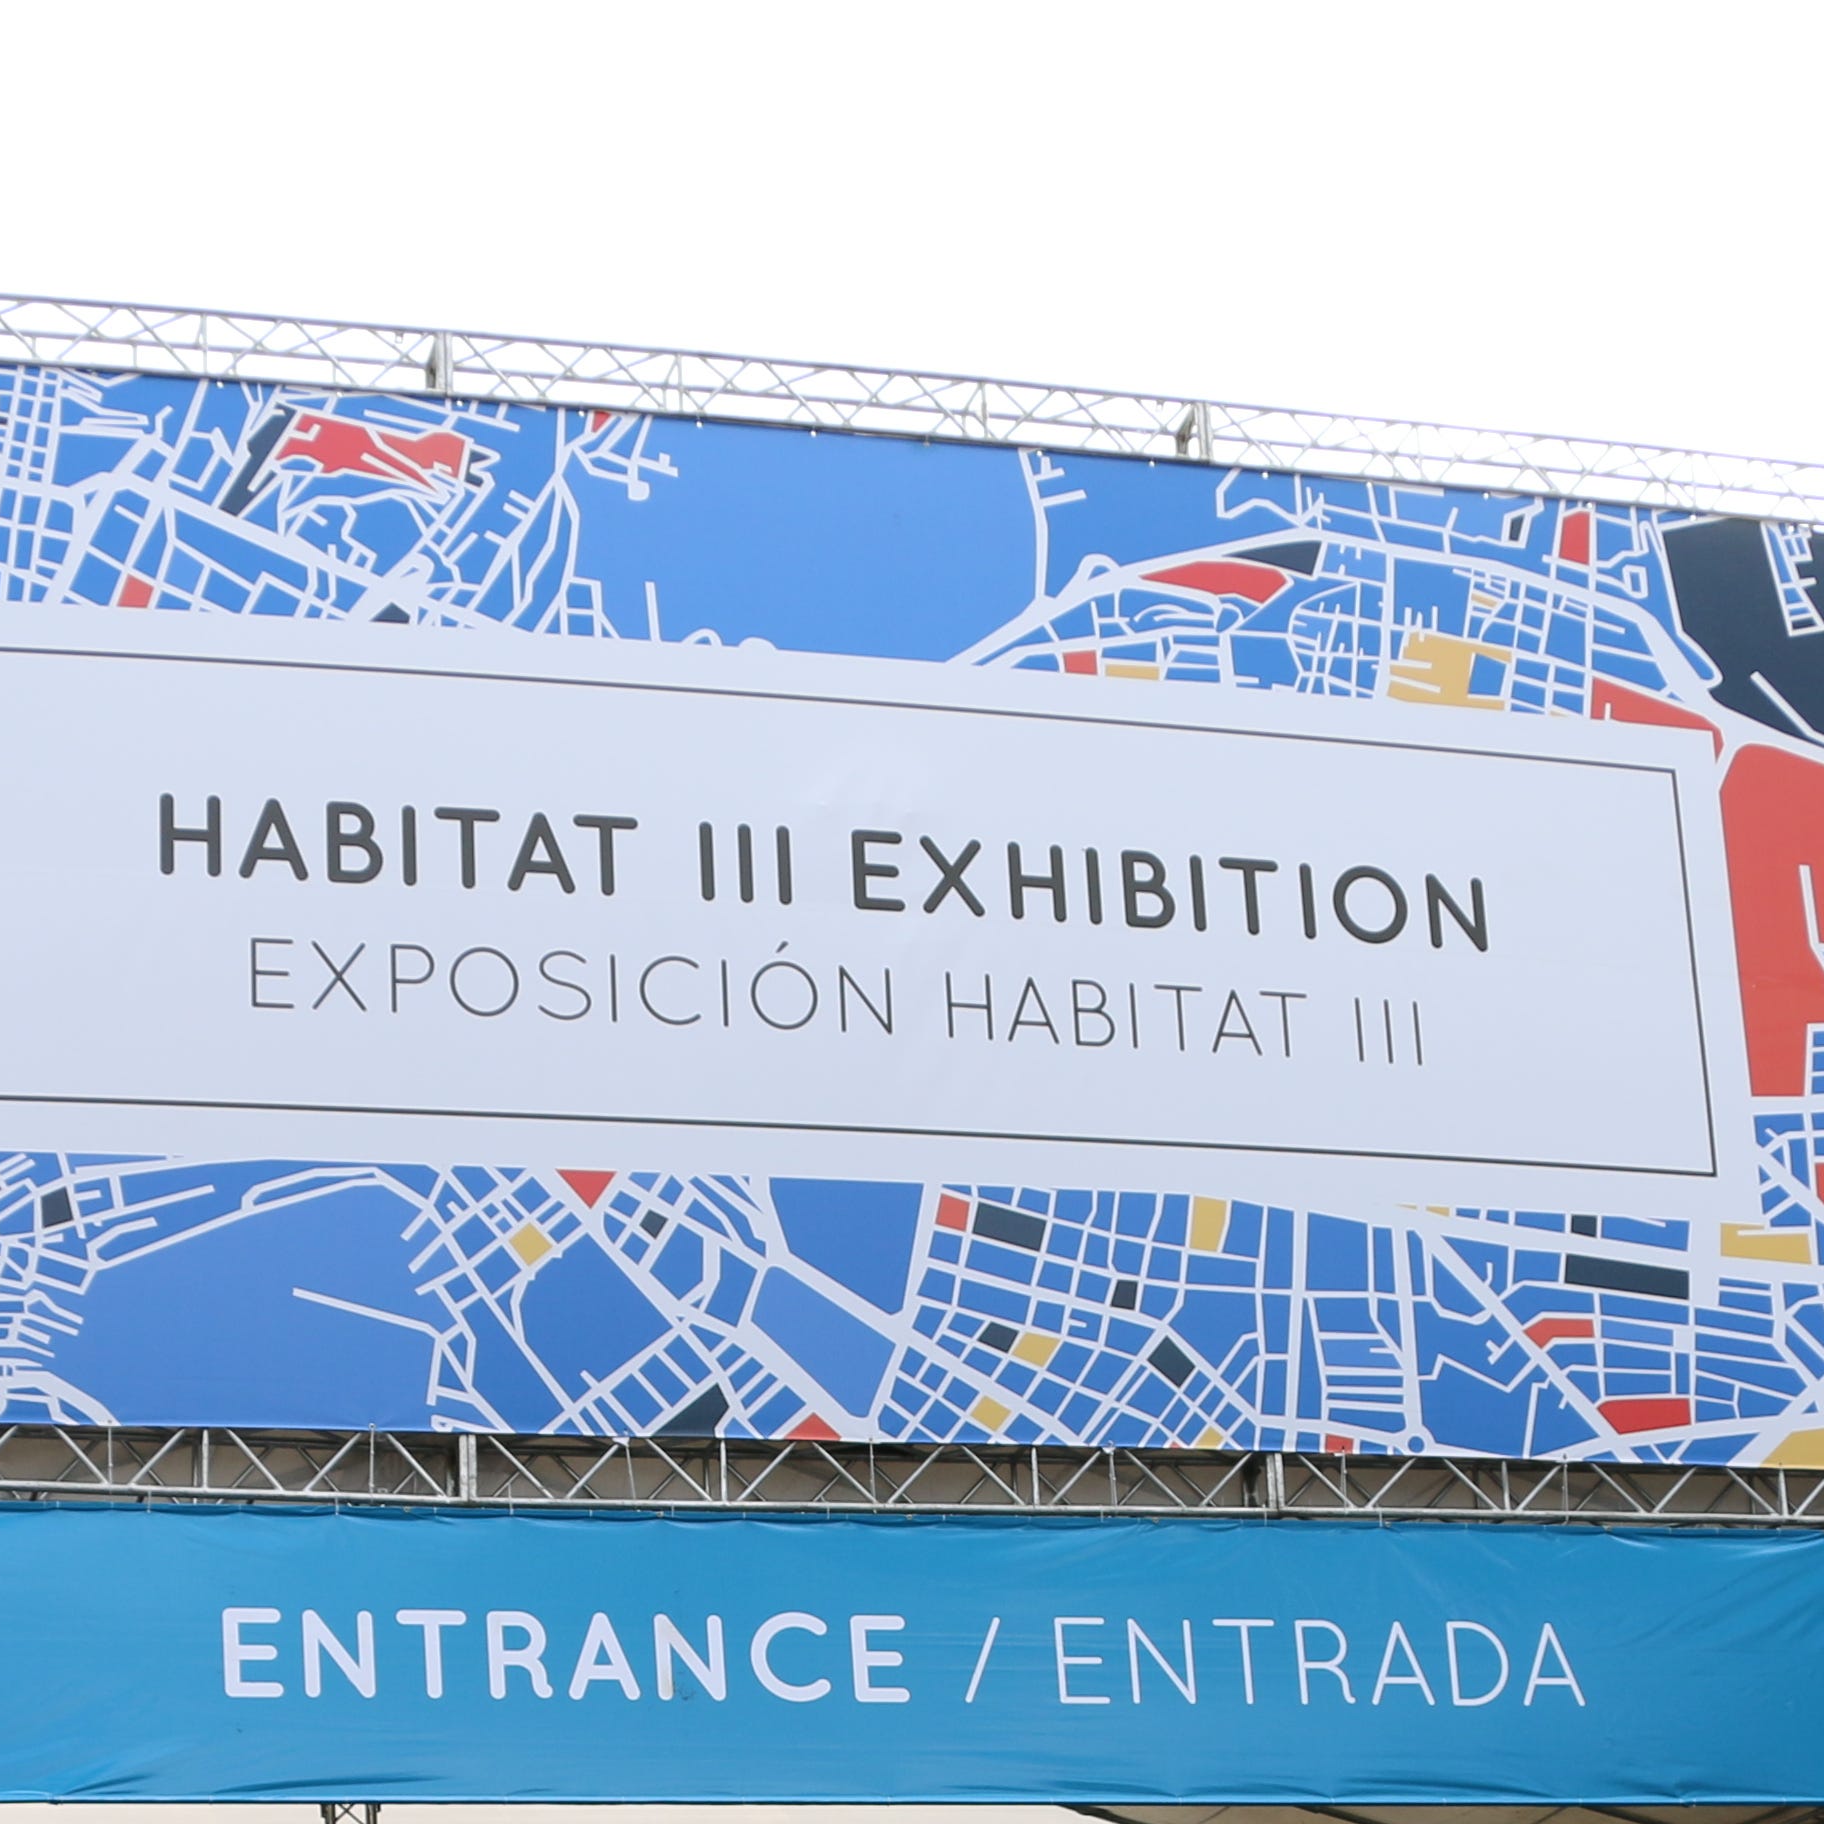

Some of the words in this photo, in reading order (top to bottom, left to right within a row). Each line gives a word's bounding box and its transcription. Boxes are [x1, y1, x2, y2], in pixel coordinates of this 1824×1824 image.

[158, 791, 639, 897] HABITAT
[698, 820, 794, 907] III
[851, 829, 1490, 954] EXHIBITION
[249, 940, 894, 1036] EXPOSICIÓN
[944, 970, 1307, 1060] HABITAT
[1352, 997, 1424, 1067] III
[225, 1606, 909, 1705] ENTRANCE
[1055, 1616, 1586, 1709] ENTRADA
